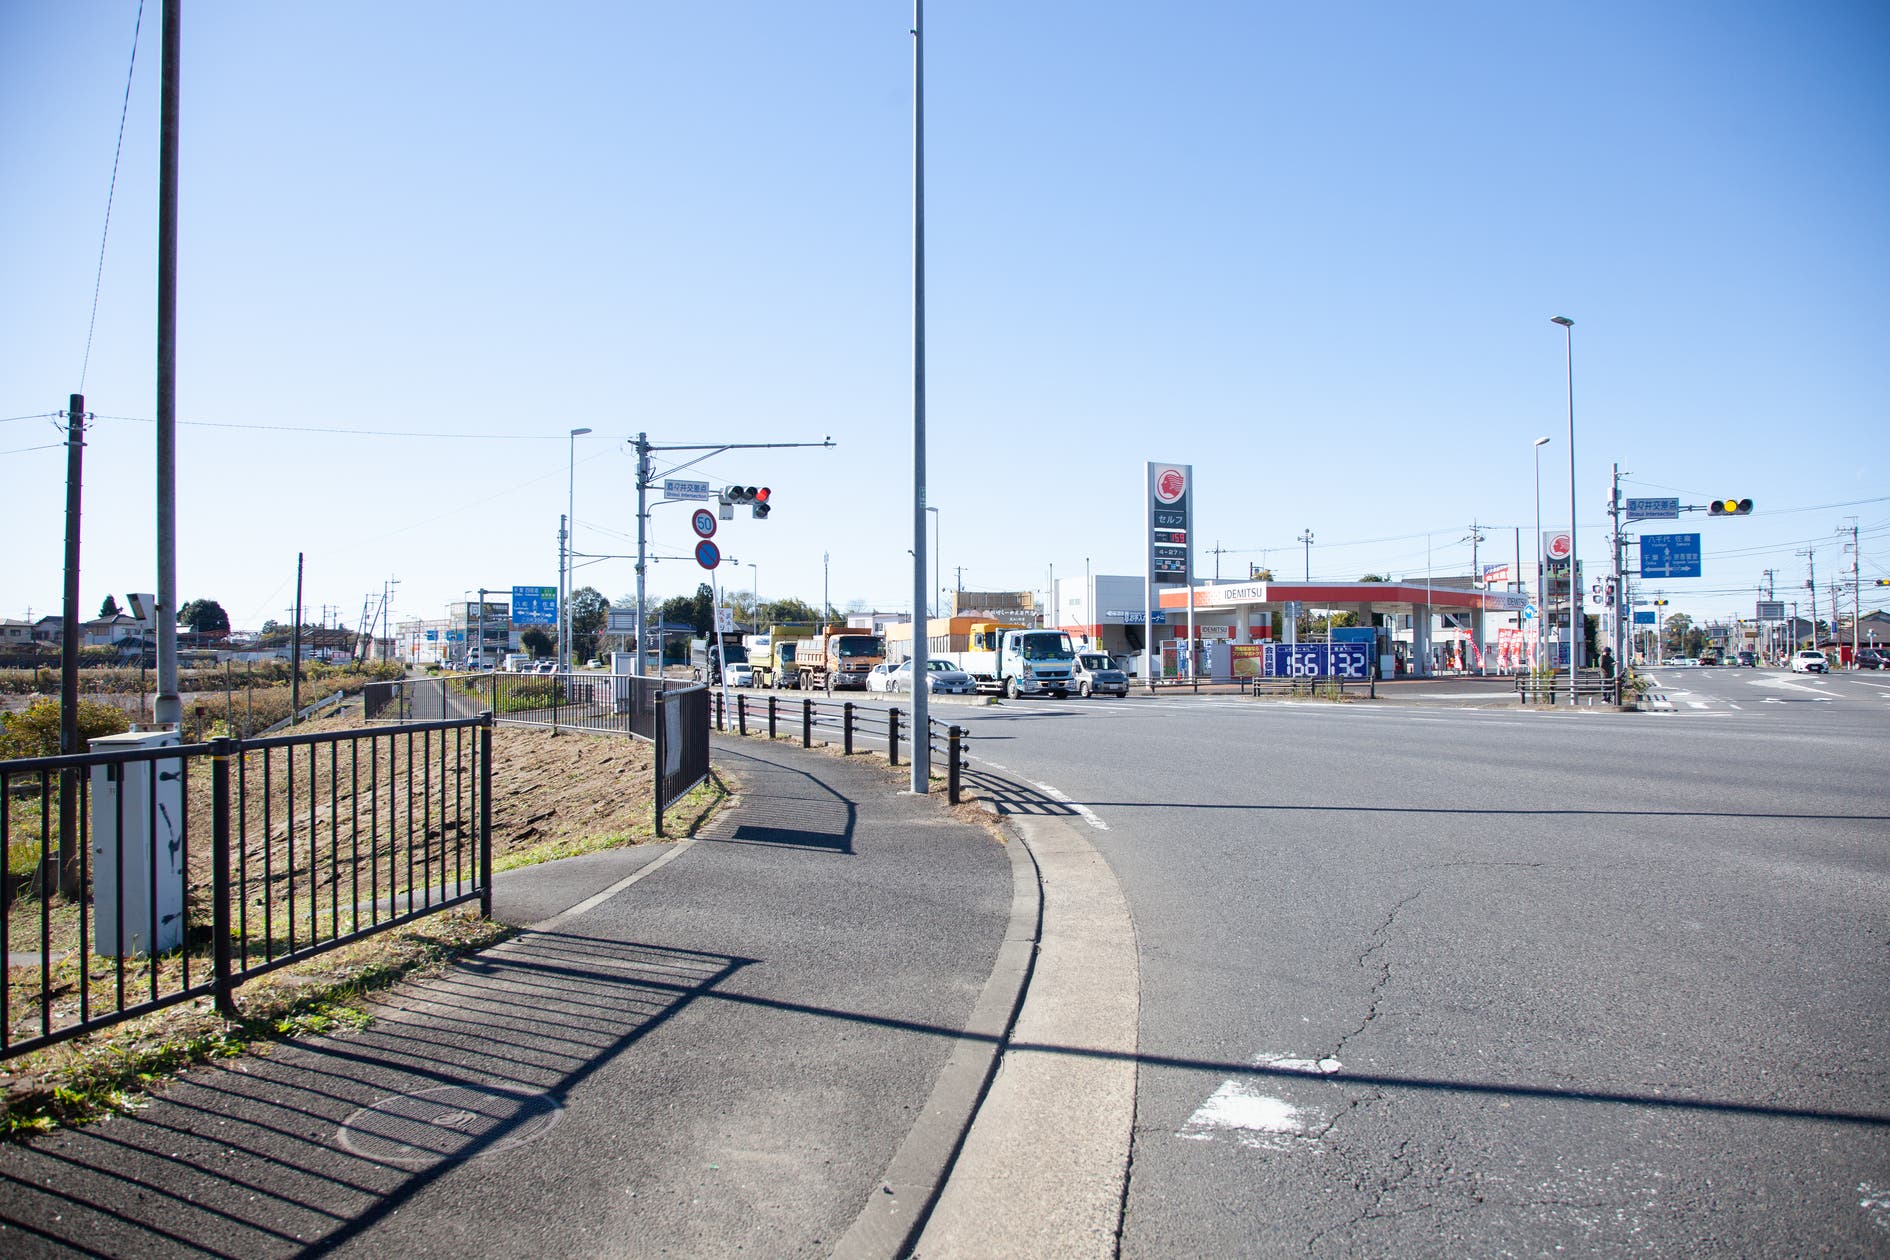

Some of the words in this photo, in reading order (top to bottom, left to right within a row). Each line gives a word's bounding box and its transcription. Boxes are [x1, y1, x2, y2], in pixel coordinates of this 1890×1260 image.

[697, 517, 712, 531] 50
[1159, 515, 1183, 524] セルフ
[1171, 533, 1185, 543] 159
[1224, 588, 1262, 600] IDEMITSU
[1286, 653, 1318, 676] 166
[1331, 653, 1365, 677] 132
